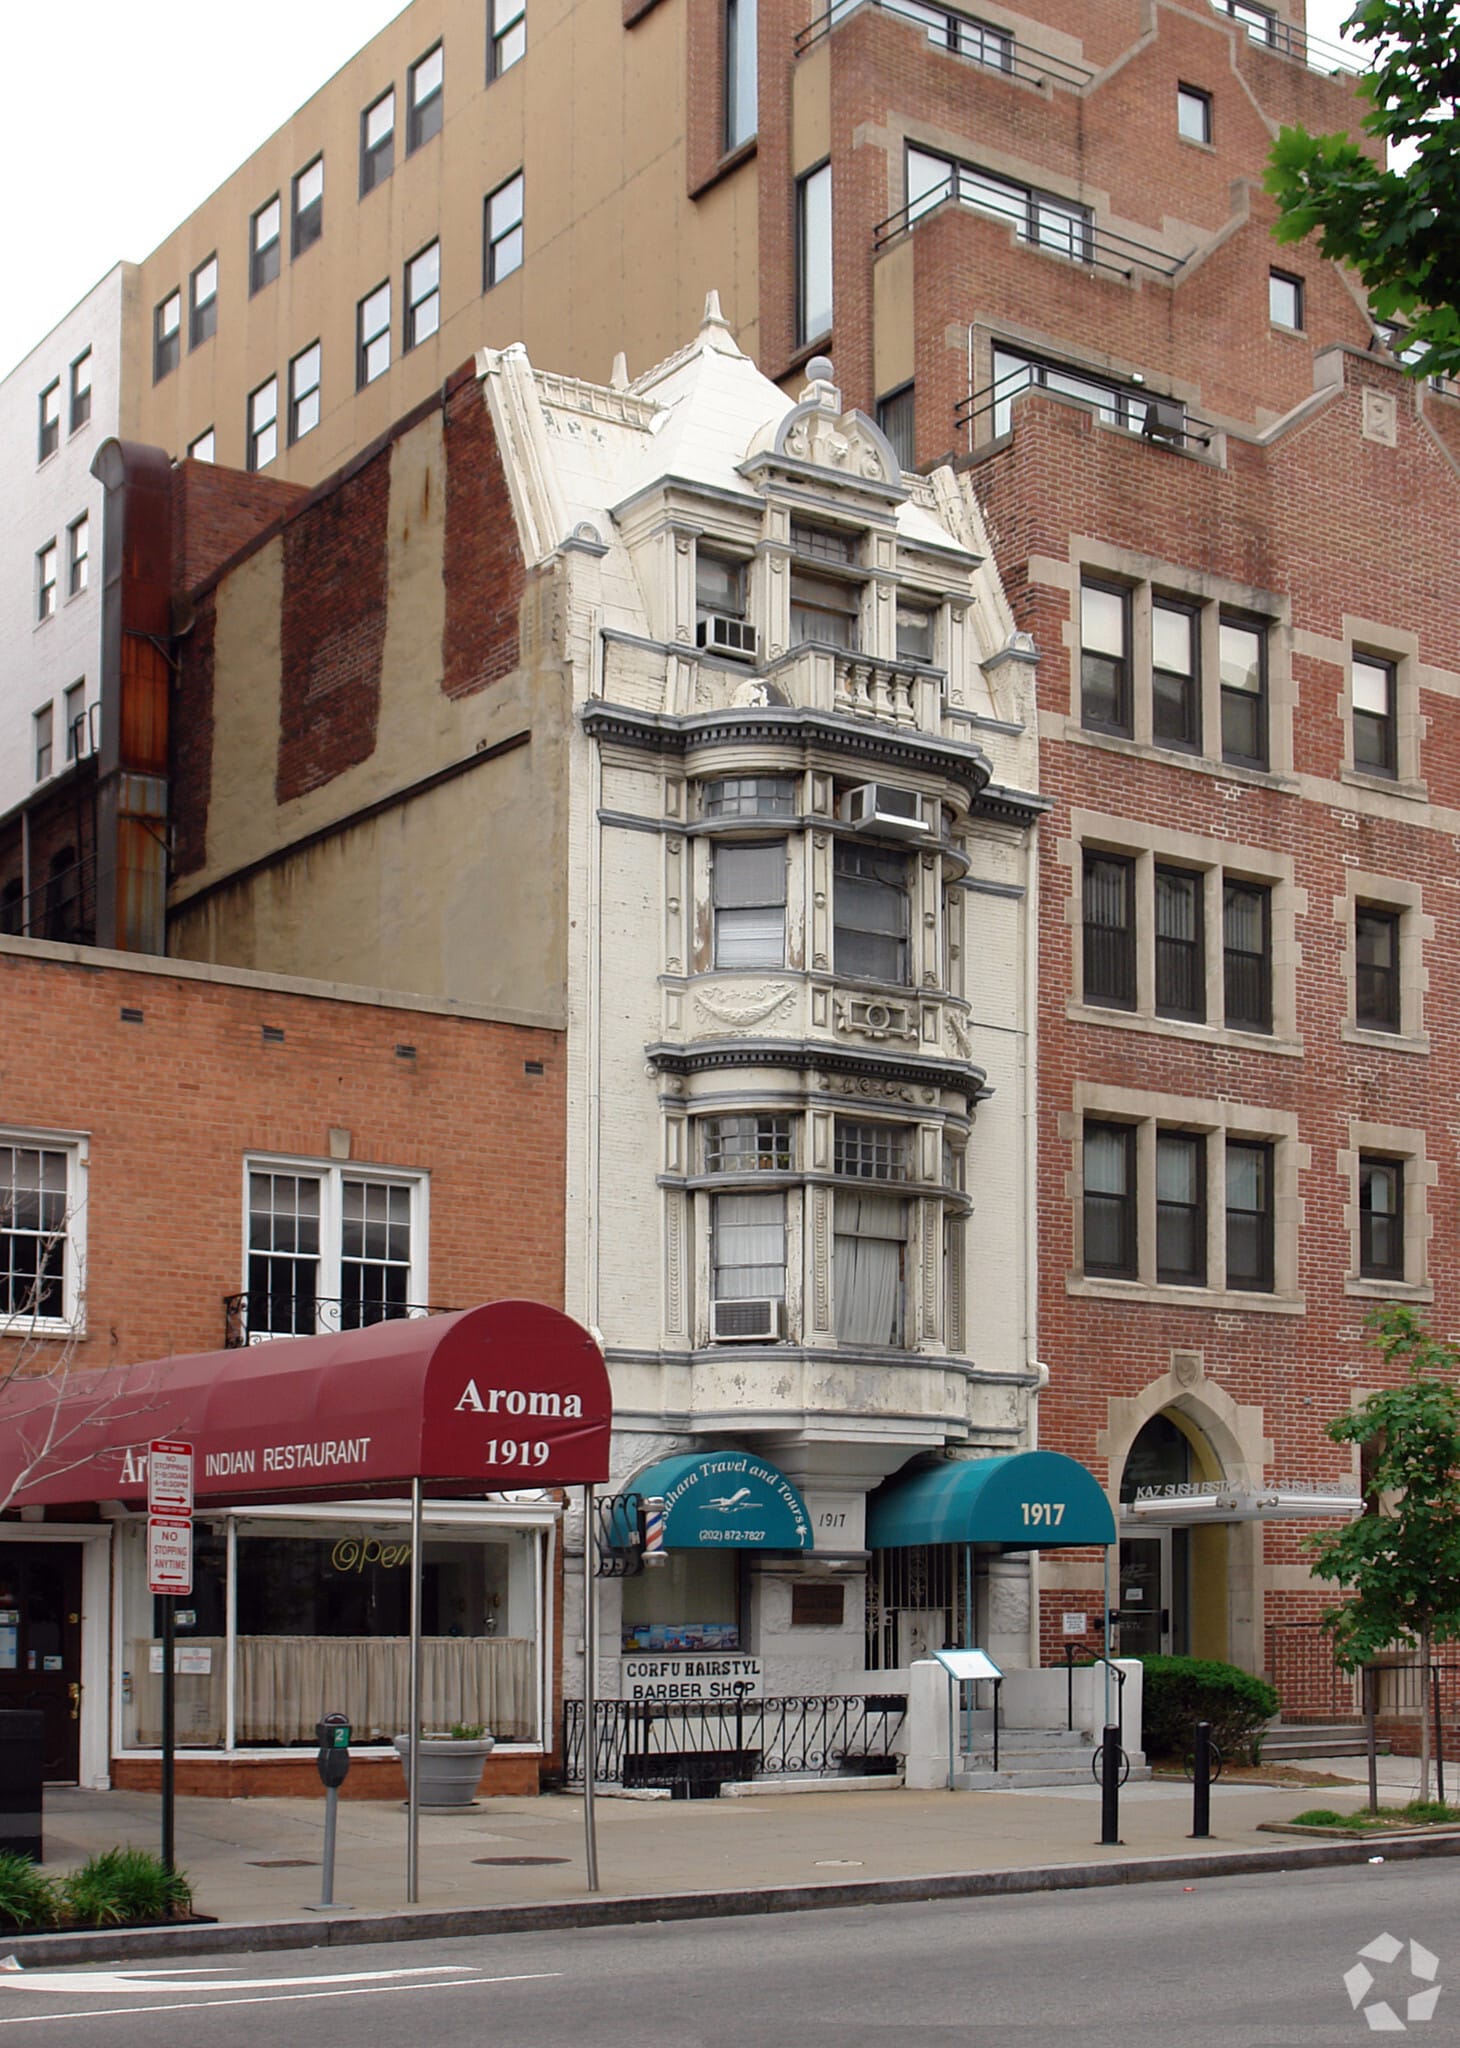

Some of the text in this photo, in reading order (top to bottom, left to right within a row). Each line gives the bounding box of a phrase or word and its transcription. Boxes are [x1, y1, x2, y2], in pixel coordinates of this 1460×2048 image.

[454, 1378, 583, 1418] Aroma
[205, 1437, 371, 1477] INDIAN RESTAURANT
[486, 1439, 550, 1467] 1919
[661, 1459, 805, 1524] Sahara Travel and Tours
[1136, 1484, 1162, 1499] KAZ
[1164, 1482, 1200, 1498] SUSHI
[818, 1513, 847, 1528] 1917
[1021, 1503, 1066, 1526] 1917
[161, 1531, 178, 1542] NO
[699, 1530, 767, 1541] (202) 872-7827
[153, 1544, 188, 1557] STOPPING
[154, 1559, 187, 1571] ANYTIME
[626, 1660, 761, 1678] CORFU HAIRSTYL
[633, 1681, 756, 1699] BARBER SHOP
[335, 1729, 345, 1741] 2
